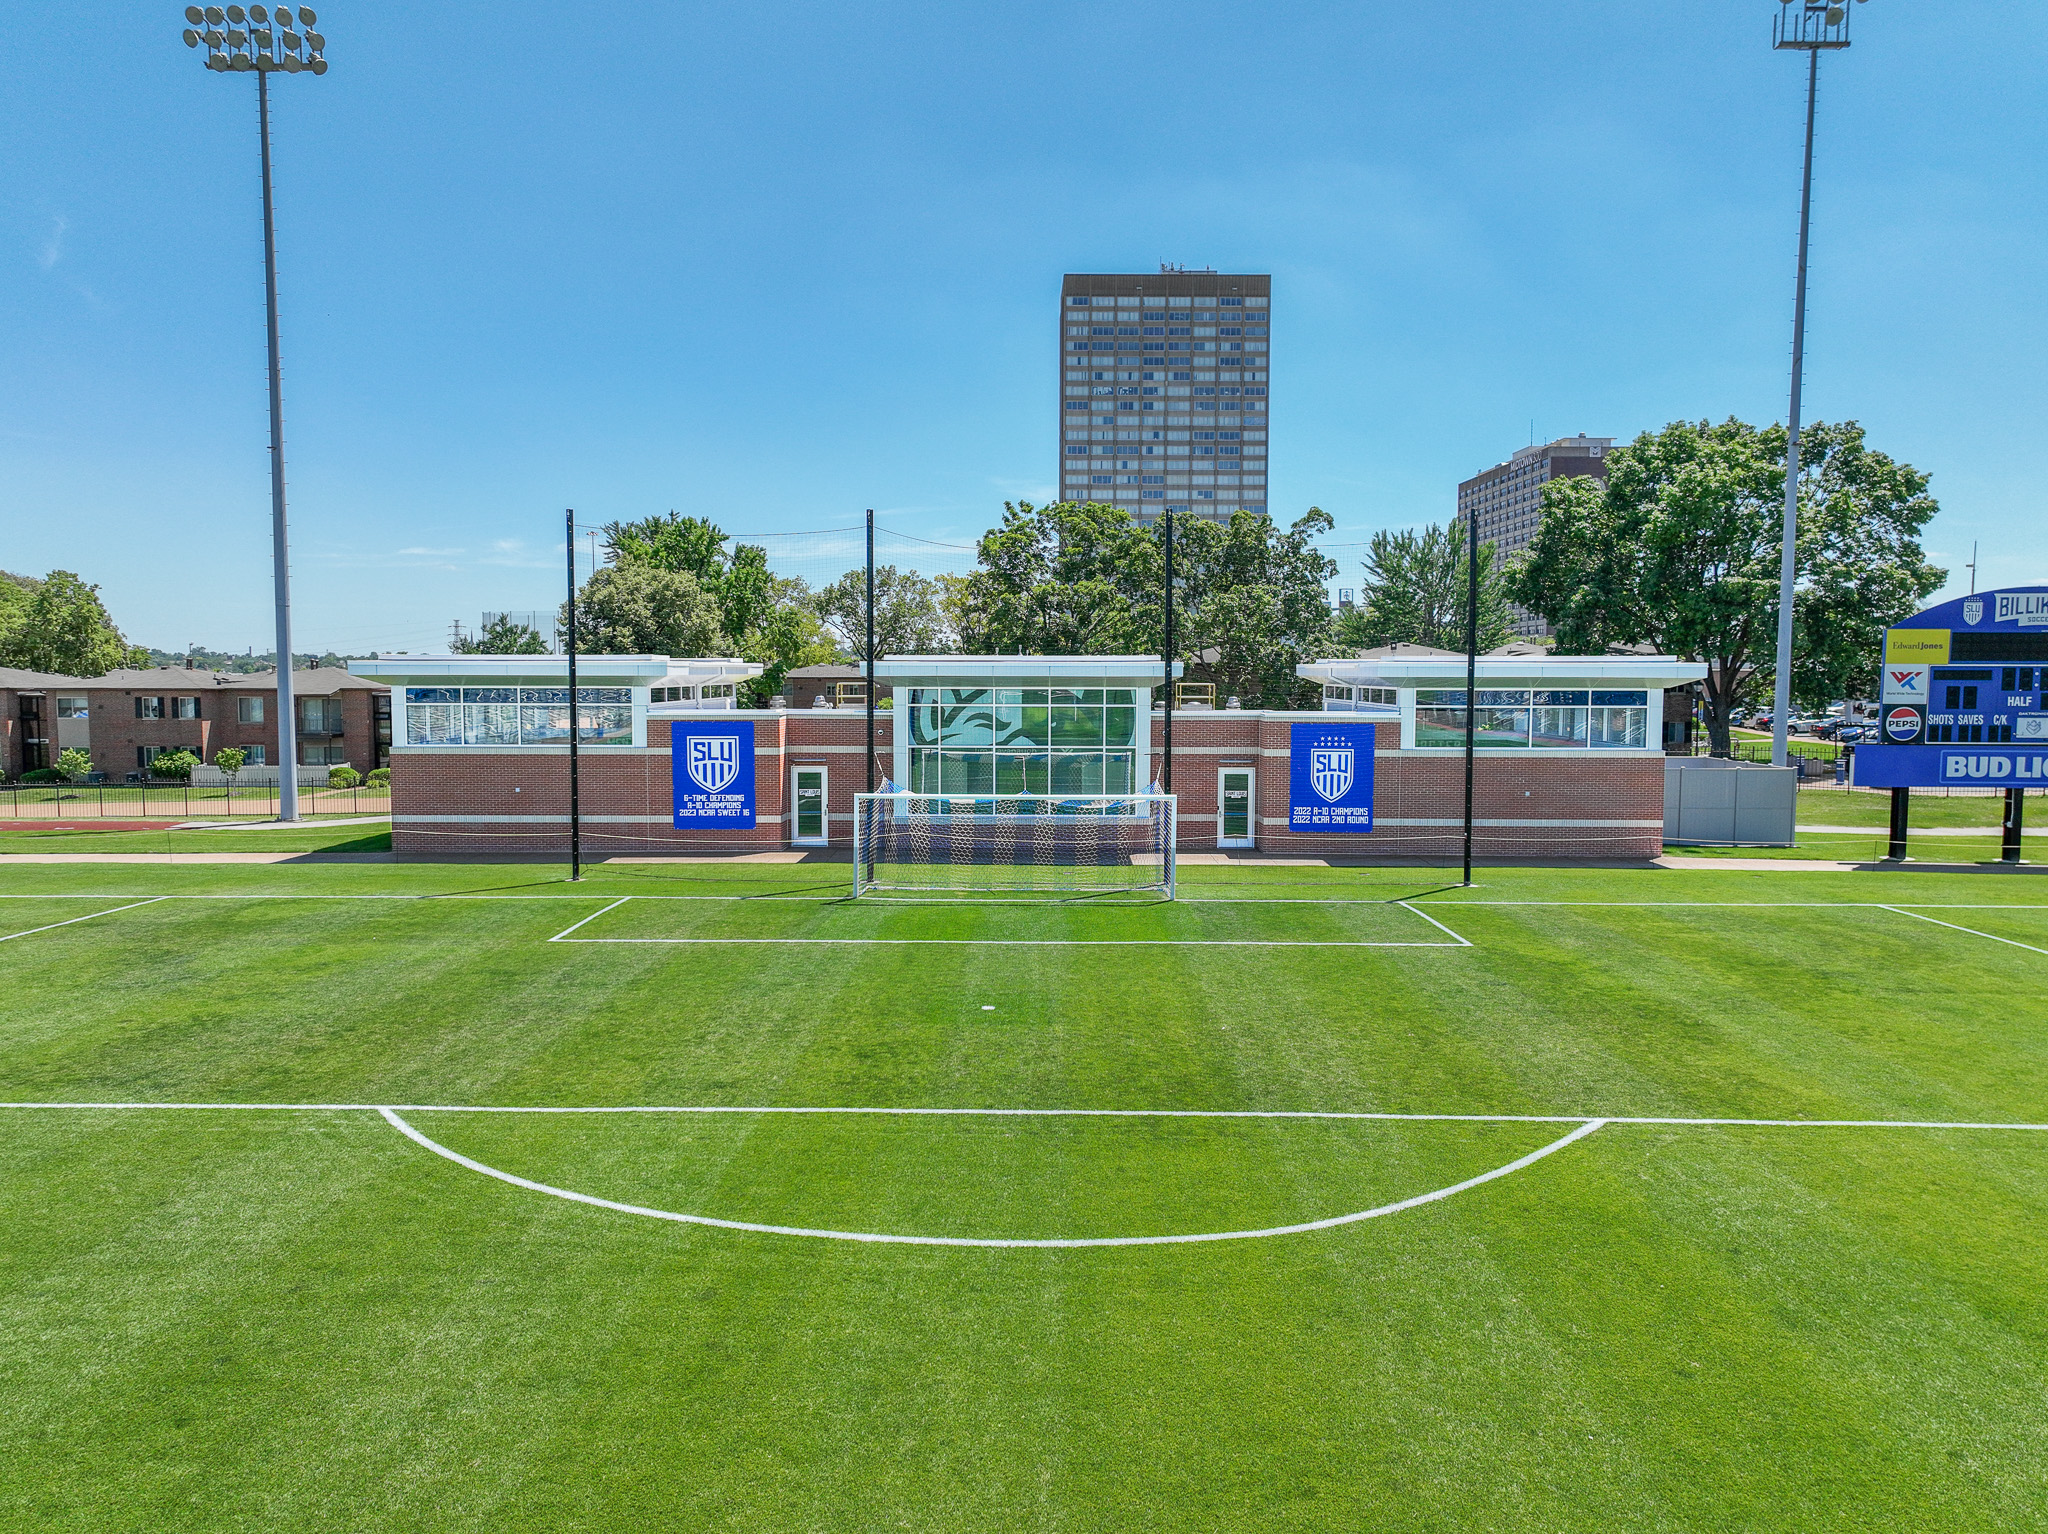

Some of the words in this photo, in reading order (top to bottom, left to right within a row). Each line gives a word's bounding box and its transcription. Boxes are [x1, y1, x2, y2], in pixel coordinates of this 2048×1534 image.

[1966, 605, 1980, 613] SLU
[2007, 696, 2032, 707] HALF
[1888, 720, 1919, 728] PEPSI
[1928, 714, 1954, 725] SHOTS
[1958, 714, 1984, 725] SAVES
[693, 741, 733, 762] SLU
[1316, 754, 1349, 773] SLU
[1946, 756, 2011, 778] BUD
[2015, 757, 2048, 778] LI
[1293, 807, 1311, 815] 2022
[1313, 807, 1328, 815] A-10
[1331, 807, 1368, 815] CHAMPIONS
[1293, 815, 1310, 823] 2022
[1312, 815, 1330, 823] NCAA
[1331, 815, 1345, 823] 2ND
[1347, 815, 1369, 824] ROUND
